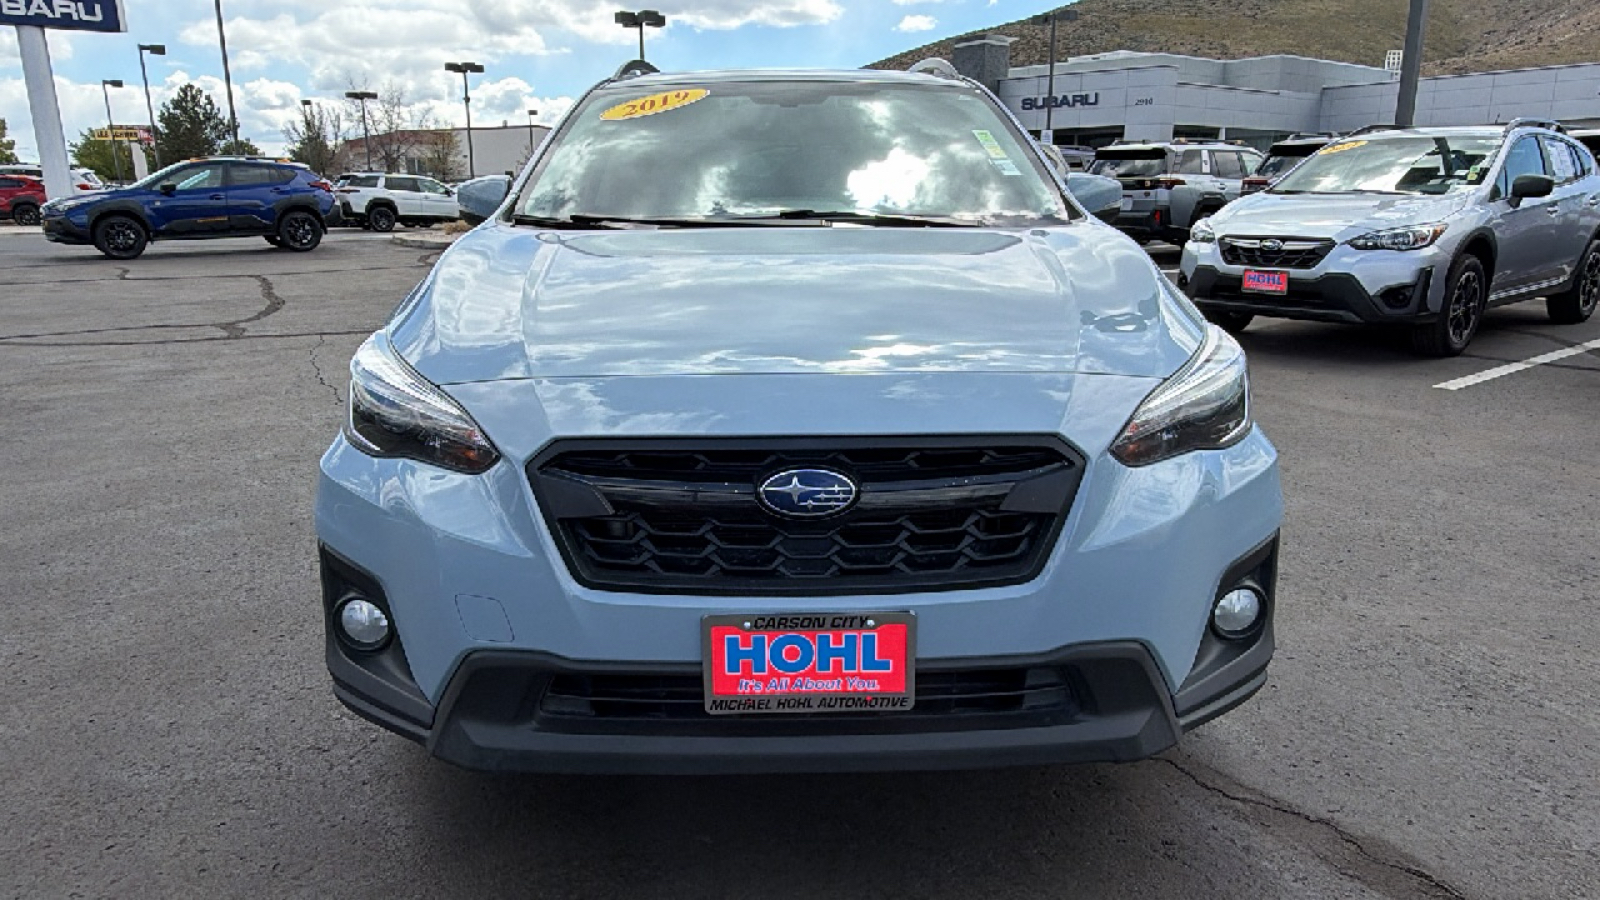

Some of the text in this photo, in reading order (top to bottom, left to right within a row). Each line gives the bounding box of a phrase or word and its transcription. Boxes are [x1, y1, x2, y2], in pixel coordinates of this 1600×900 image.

[622, 91, 690, 116] 2019
[1021, 92, 1099, 110] SUBARU
[754, 615, 870, 629] CARSON CITY
[725, 632, 893, 675] HOHL
[738, 678, 762, 692] It's
[767, 677, 789, 691] All
[791, 676, 842, 691] About
[709, 696, 910, 711] MICHAEL HOHL AUTOMOTIVE
